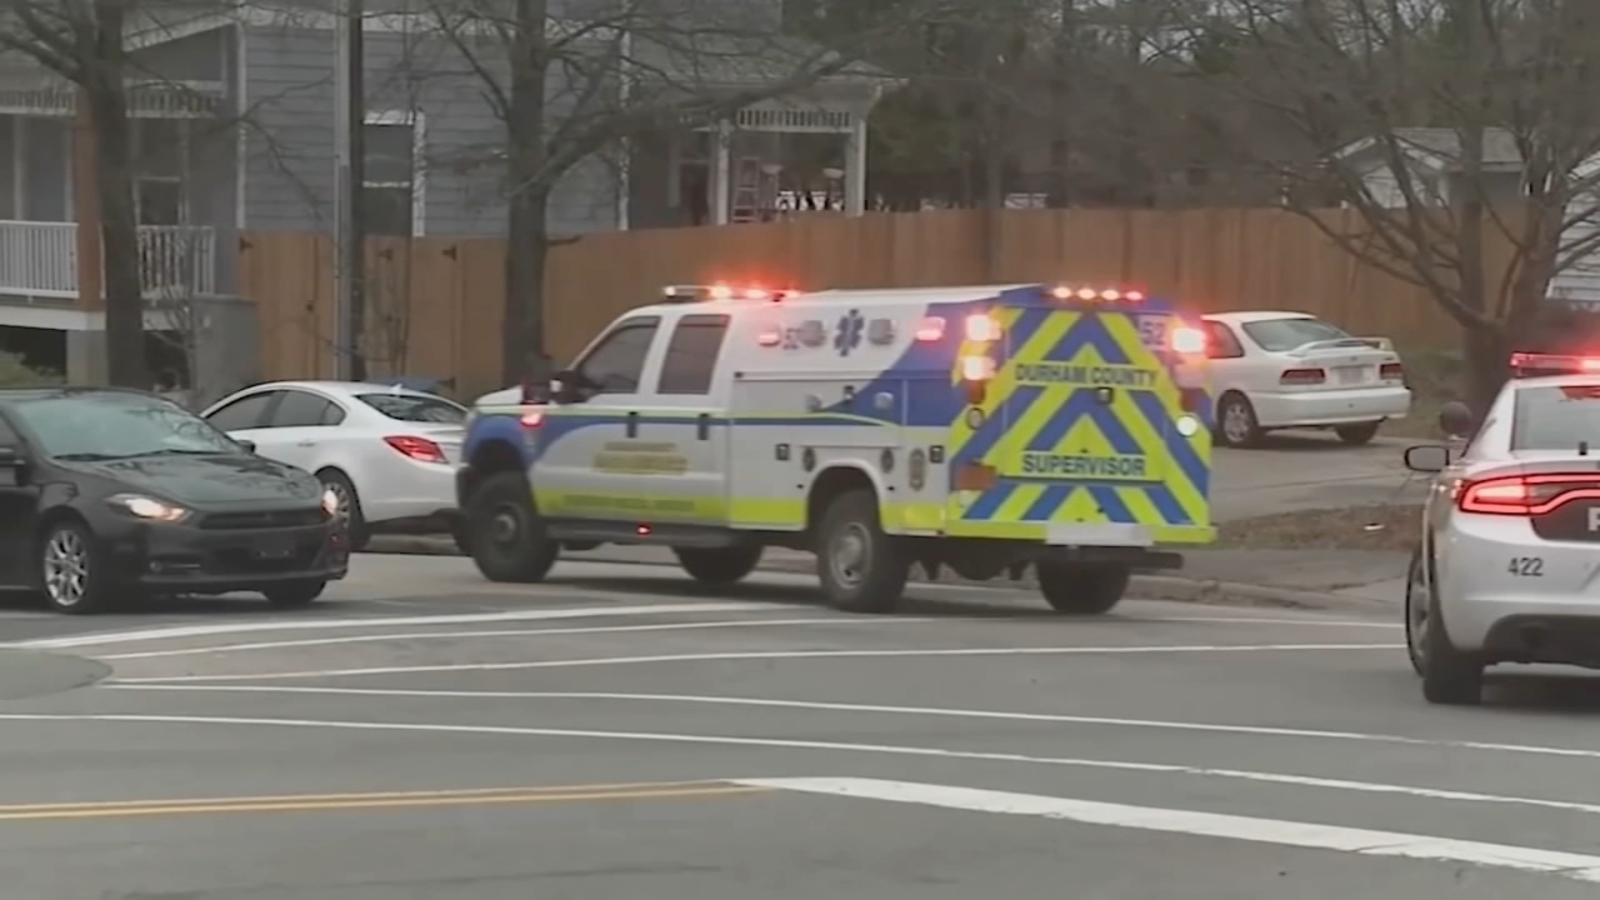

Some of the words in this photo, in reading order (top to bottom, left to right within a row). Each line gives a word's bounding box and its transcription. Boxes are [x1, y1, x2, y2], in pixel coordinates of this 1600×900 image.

[1142, 320, 1165, 346] 52
[1015, 363, 1087, 384] DURHAM
[1092, 366, 1158, 387] COUNTY
[1022, 454, 1146, 477] SUPERVISOR
[1508, 557, 1544, 577] 422
